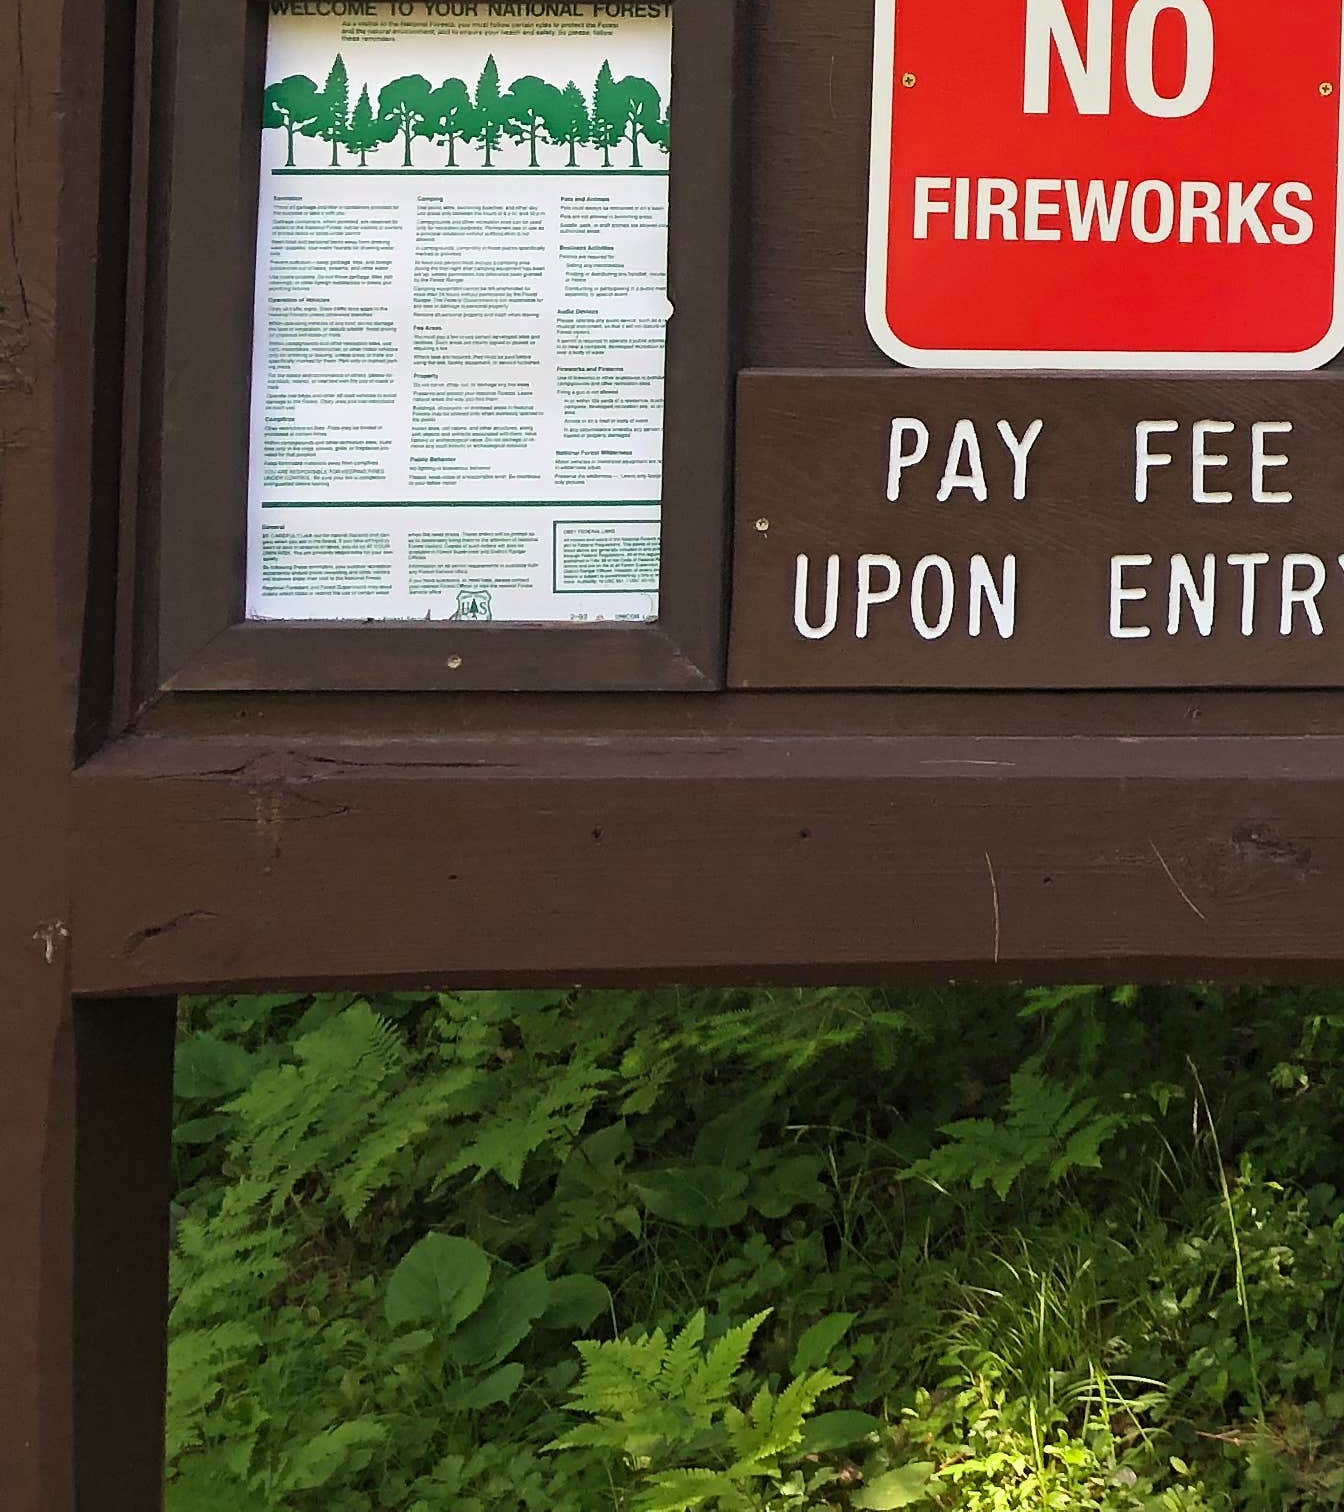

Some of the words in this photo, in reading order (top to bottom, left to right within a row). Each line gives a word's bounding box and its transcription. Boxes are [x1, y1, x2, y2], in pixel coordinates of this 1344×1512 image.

[270, 0, 377, 17] WELCOME
[389, 1, 414, 17] TO
[424, 1, 478, 17] YOUR
[488, 2, 584, 17] NATIONAL
[593, 2, 672, 18] FOREST
[914, 177, 1313, 244] FIREWORKS
[887, 418, 1043, 502] PAY
[1135, 420, 1292, 503] FEE
[794, 554, 1015, 639] UPON
